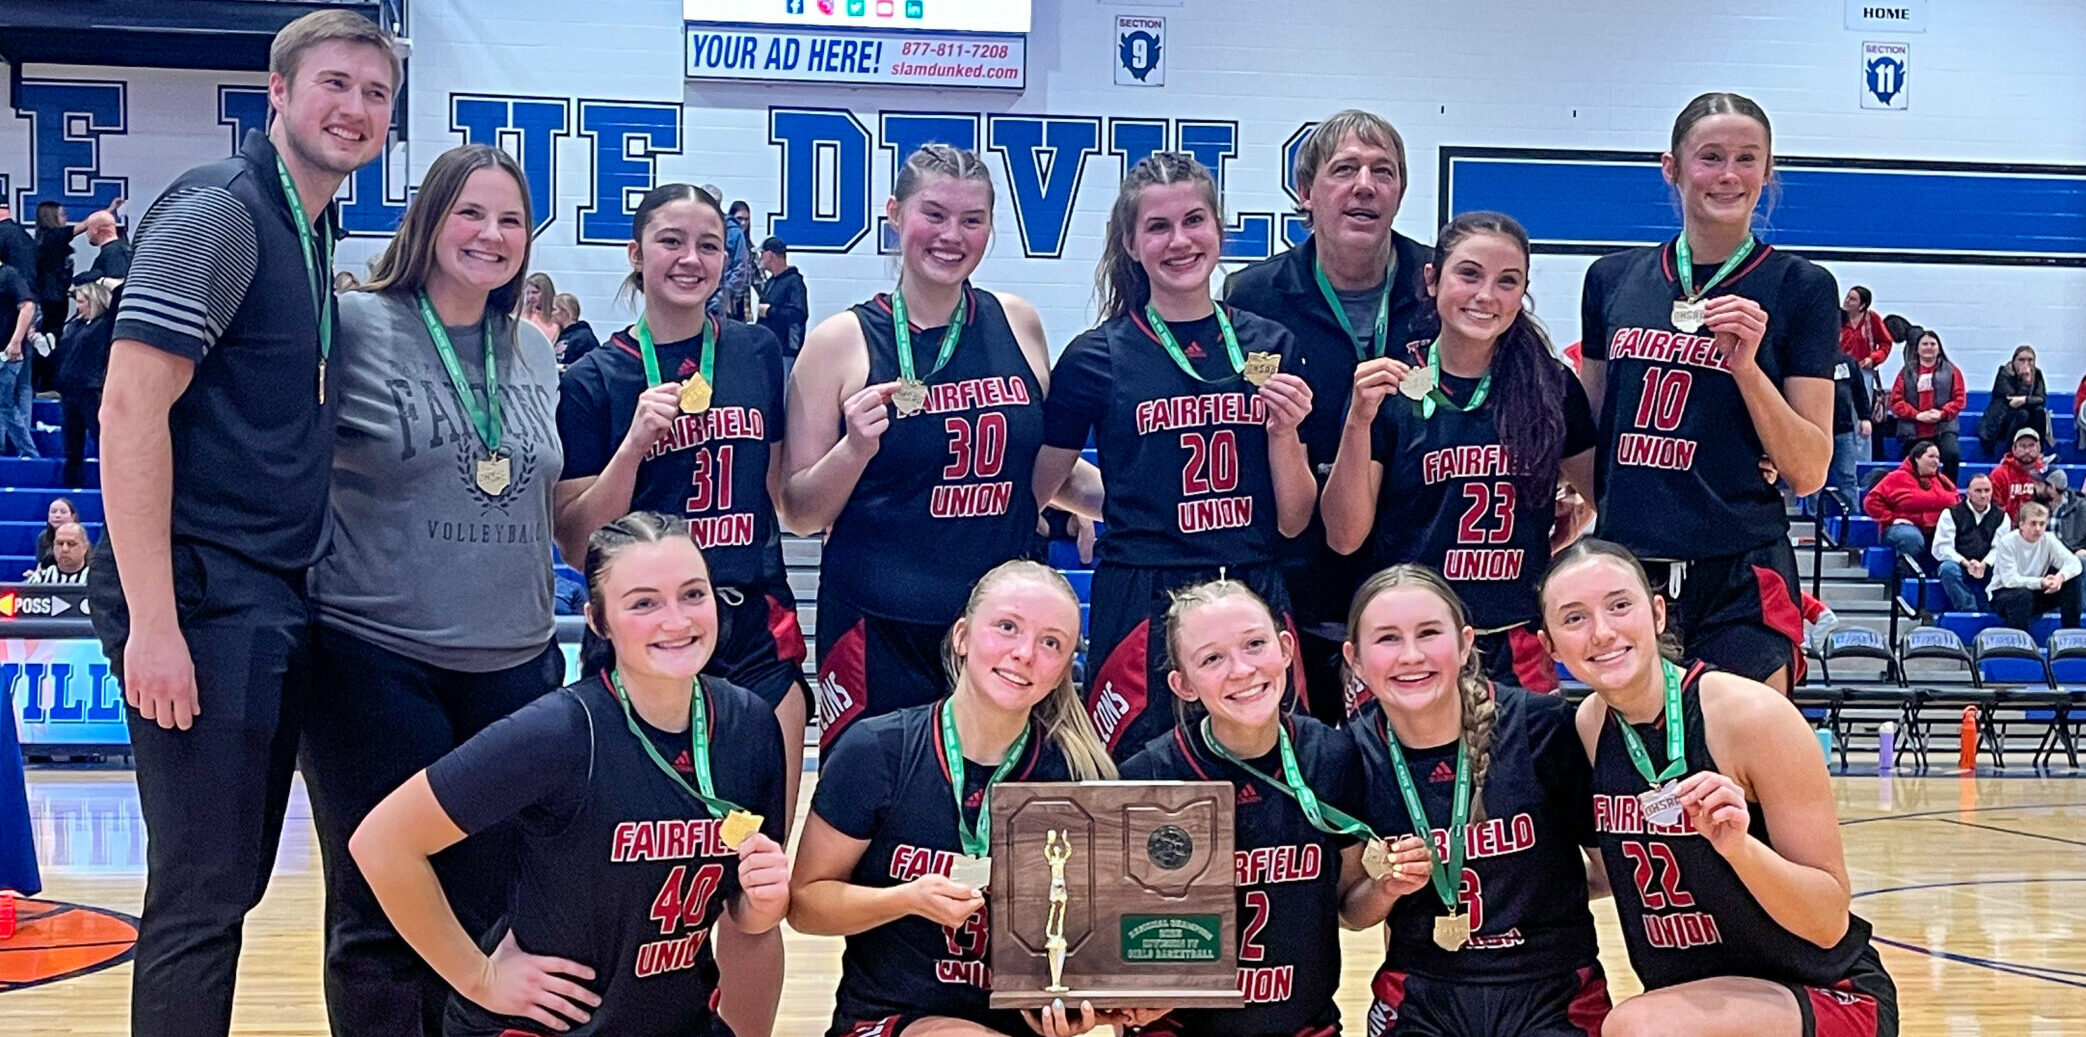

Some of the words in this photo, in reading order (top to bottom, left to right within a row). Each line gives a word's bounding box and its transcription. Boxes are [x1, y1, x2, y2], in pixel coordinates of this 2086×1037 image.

[1119, 19, 1162, 28] SECTION
[1863, 7, 1910, 20] HOME
[693, 34, 756, 69] YOUR
[764, 37, 799, 71] AD
[808, 39, 882, 74] HERE!
[902, 42, 1009, 59] 877-811-7208
[1132, 39, 1148, 69] 9
[1866, 45, 1906, 54] SECTION
[891, 62, 1018, 80] slamdunked.com
[1875, 63, 1895, 93] 11
[0, 80, 128, 228] E
[218, 84, 684, 246] LUE
[767, 105, 1318, 263] DVL
[897, 376, 1030, 418] AIRFIELD
[1136, 393, 1266, 435] FAIRFIELD
[1634, 367, 1692, 431] 10
[944, 412, 1007, 480] 30
[1181, 430, 1238, 496] 20
[1423, 445, 1531, 485] FAIRFI
[1617, 433, 1697, 470] UNION
[687, 445, 733, 513] 31
[930, 482, 1013, 518] UNION
[1178, 496, 1253, 533] UNION
[1457, 482, 1516, 544] 23
[688, 513, 754, 549] NION
[1444, 549, 1524, 580] UNION
[14, 598, 51, 614] POSS
[820, 670, 853, 738] CONS
[1093, 681, 1130, 746] CONS
[611, 819, 739, 863] FAIRFIE
[1235, 844, 1322, 887] RFIELD
[1622, 841, 1695, 910] 22
[650, 864, 723, 934] 40
[1239, 891, 1270, 962] 2
[1643, 912, 1722, 949] UNION
[1237, 965, 1294, 1003] ION
